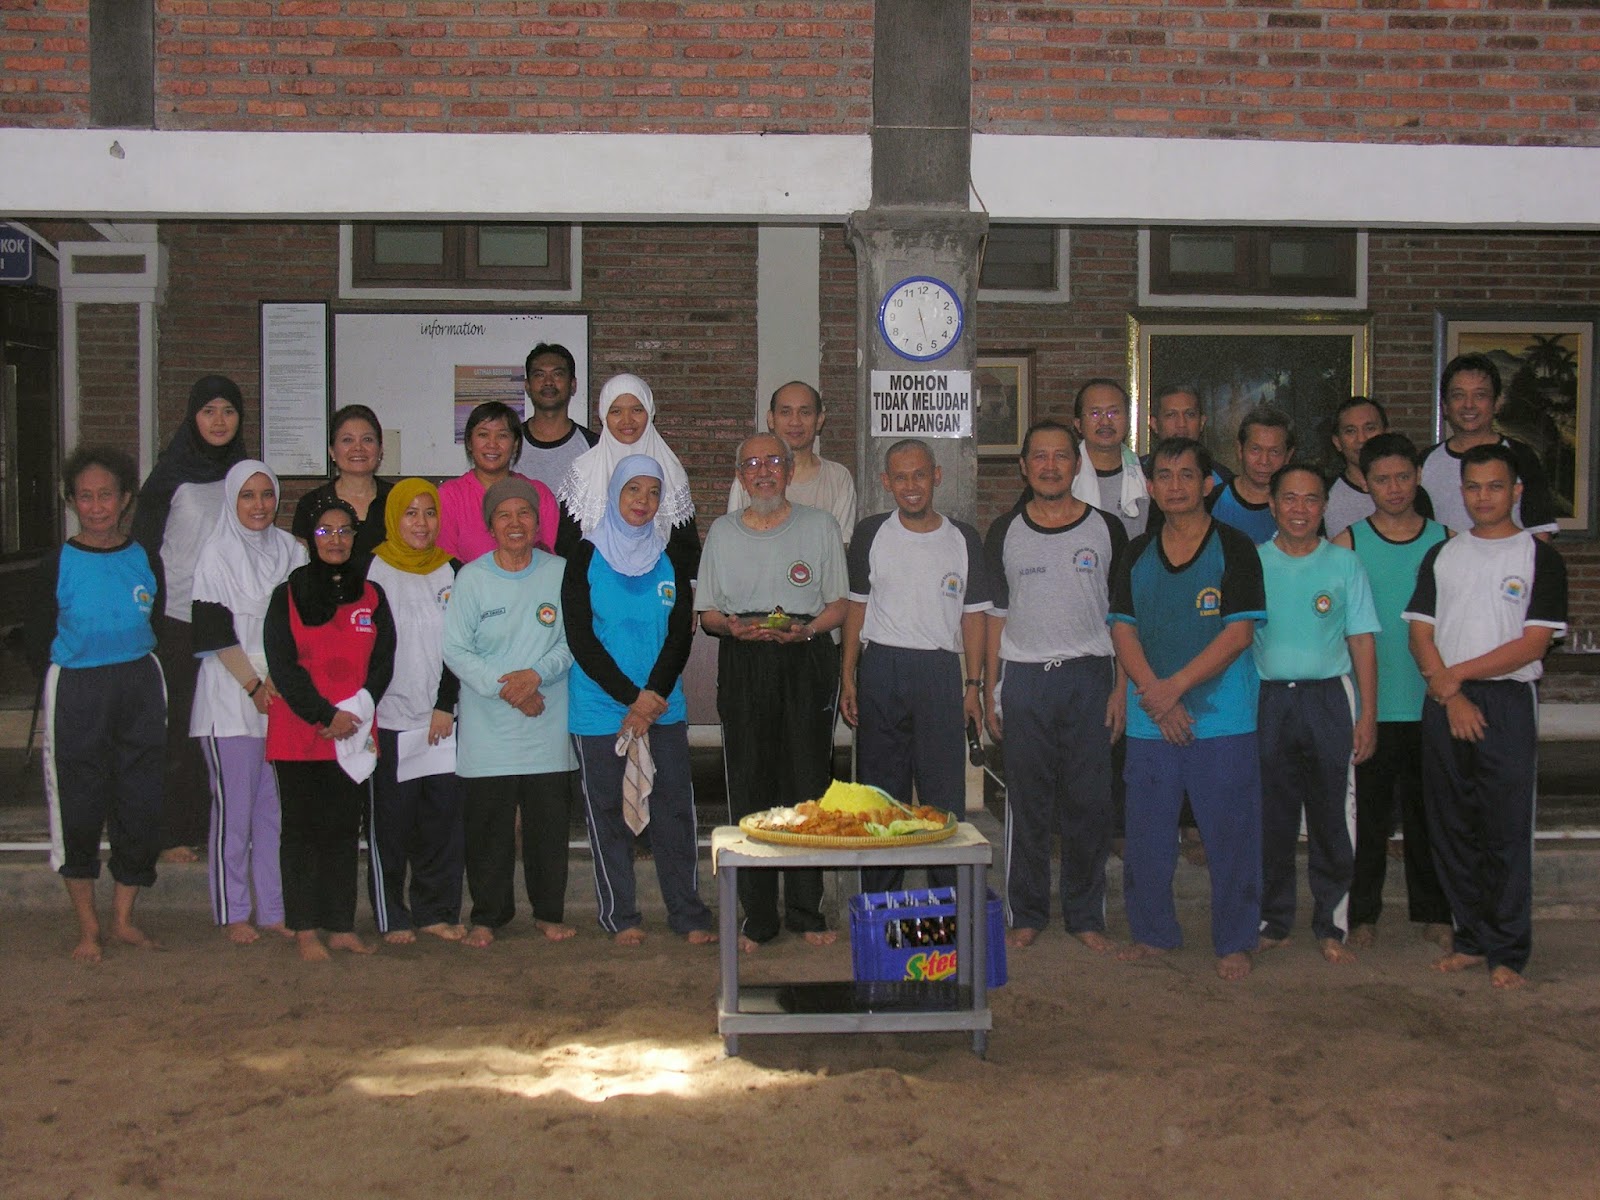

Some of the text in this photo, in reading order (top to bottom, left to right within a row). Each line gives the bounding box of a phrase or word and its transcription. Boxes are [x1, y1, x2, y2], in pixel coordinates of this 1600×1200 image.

[904, 289, 914, 298] 11
[917, 286, 929, 295] 12
[934, 290, 940, 299] 1
[943, 301, 950, 311] 2
[946, 316, 953, 325] 3
[420, 319, 487, 339] information
[941, 330, 948, 339] 4
[916, 343, 923, 352] 6
[930, 340, 937, 349] 5
[890, 375, 948, 391] MOHON
[873, 392, 969, 411] TIDAK MELUDAH
[881, 413, 961, 432] DI LAPANGAN
